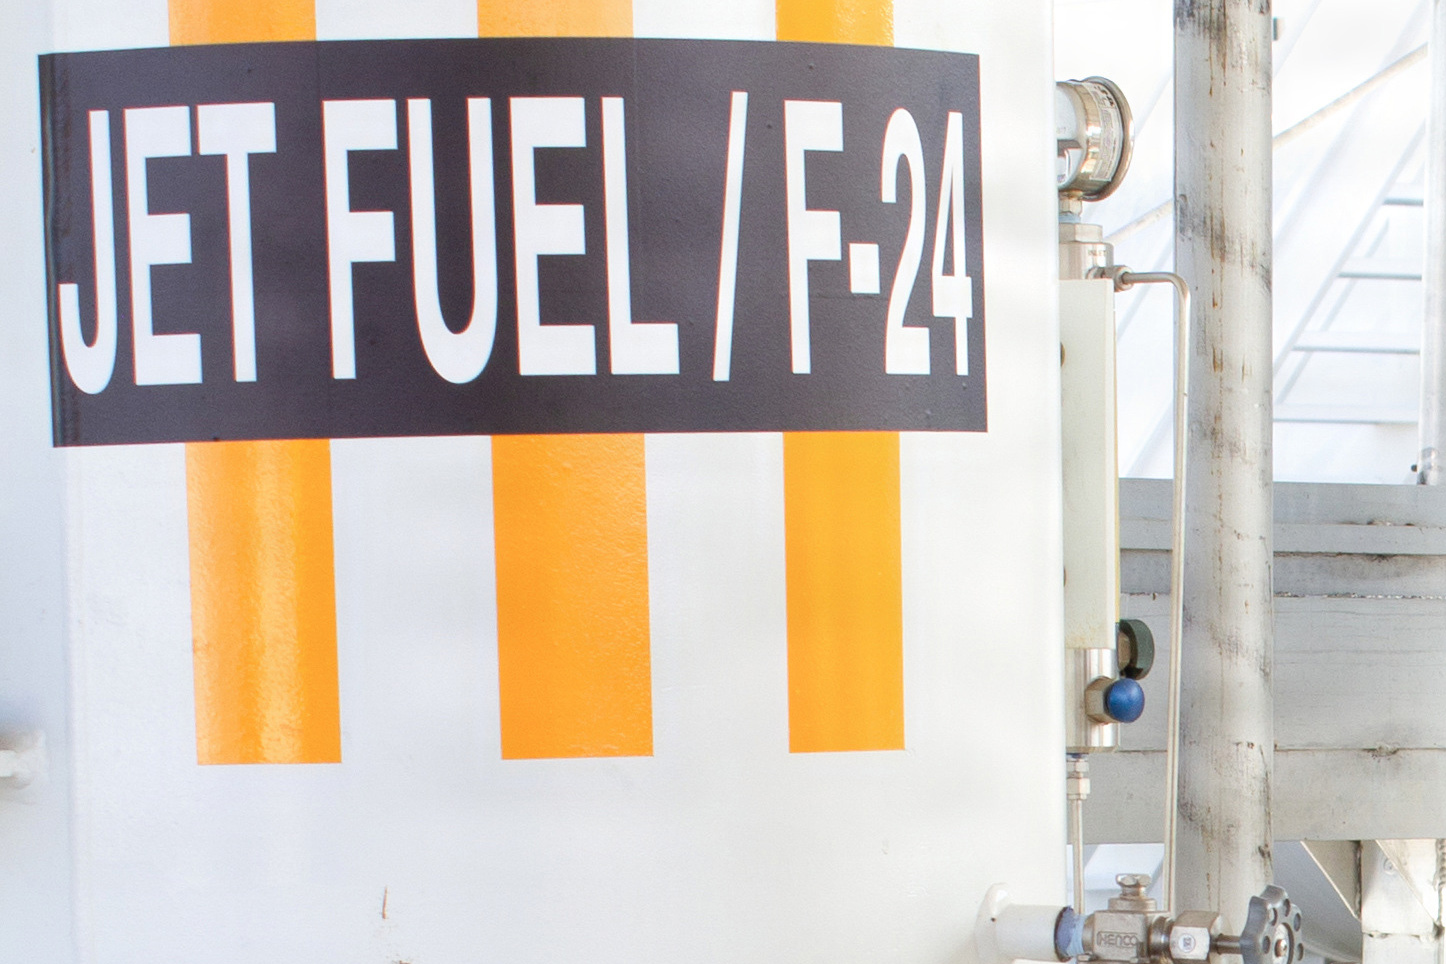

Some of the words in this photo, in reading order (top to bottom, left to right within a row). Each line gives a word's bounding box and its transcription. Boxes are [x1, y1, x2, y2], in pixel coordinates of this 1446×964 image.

[58, 102, 278, 394] JET
[321, 96, 681, 384] FUEL
[711, 90, 748, 382] /
[784, 99, 973, 375] F-24
